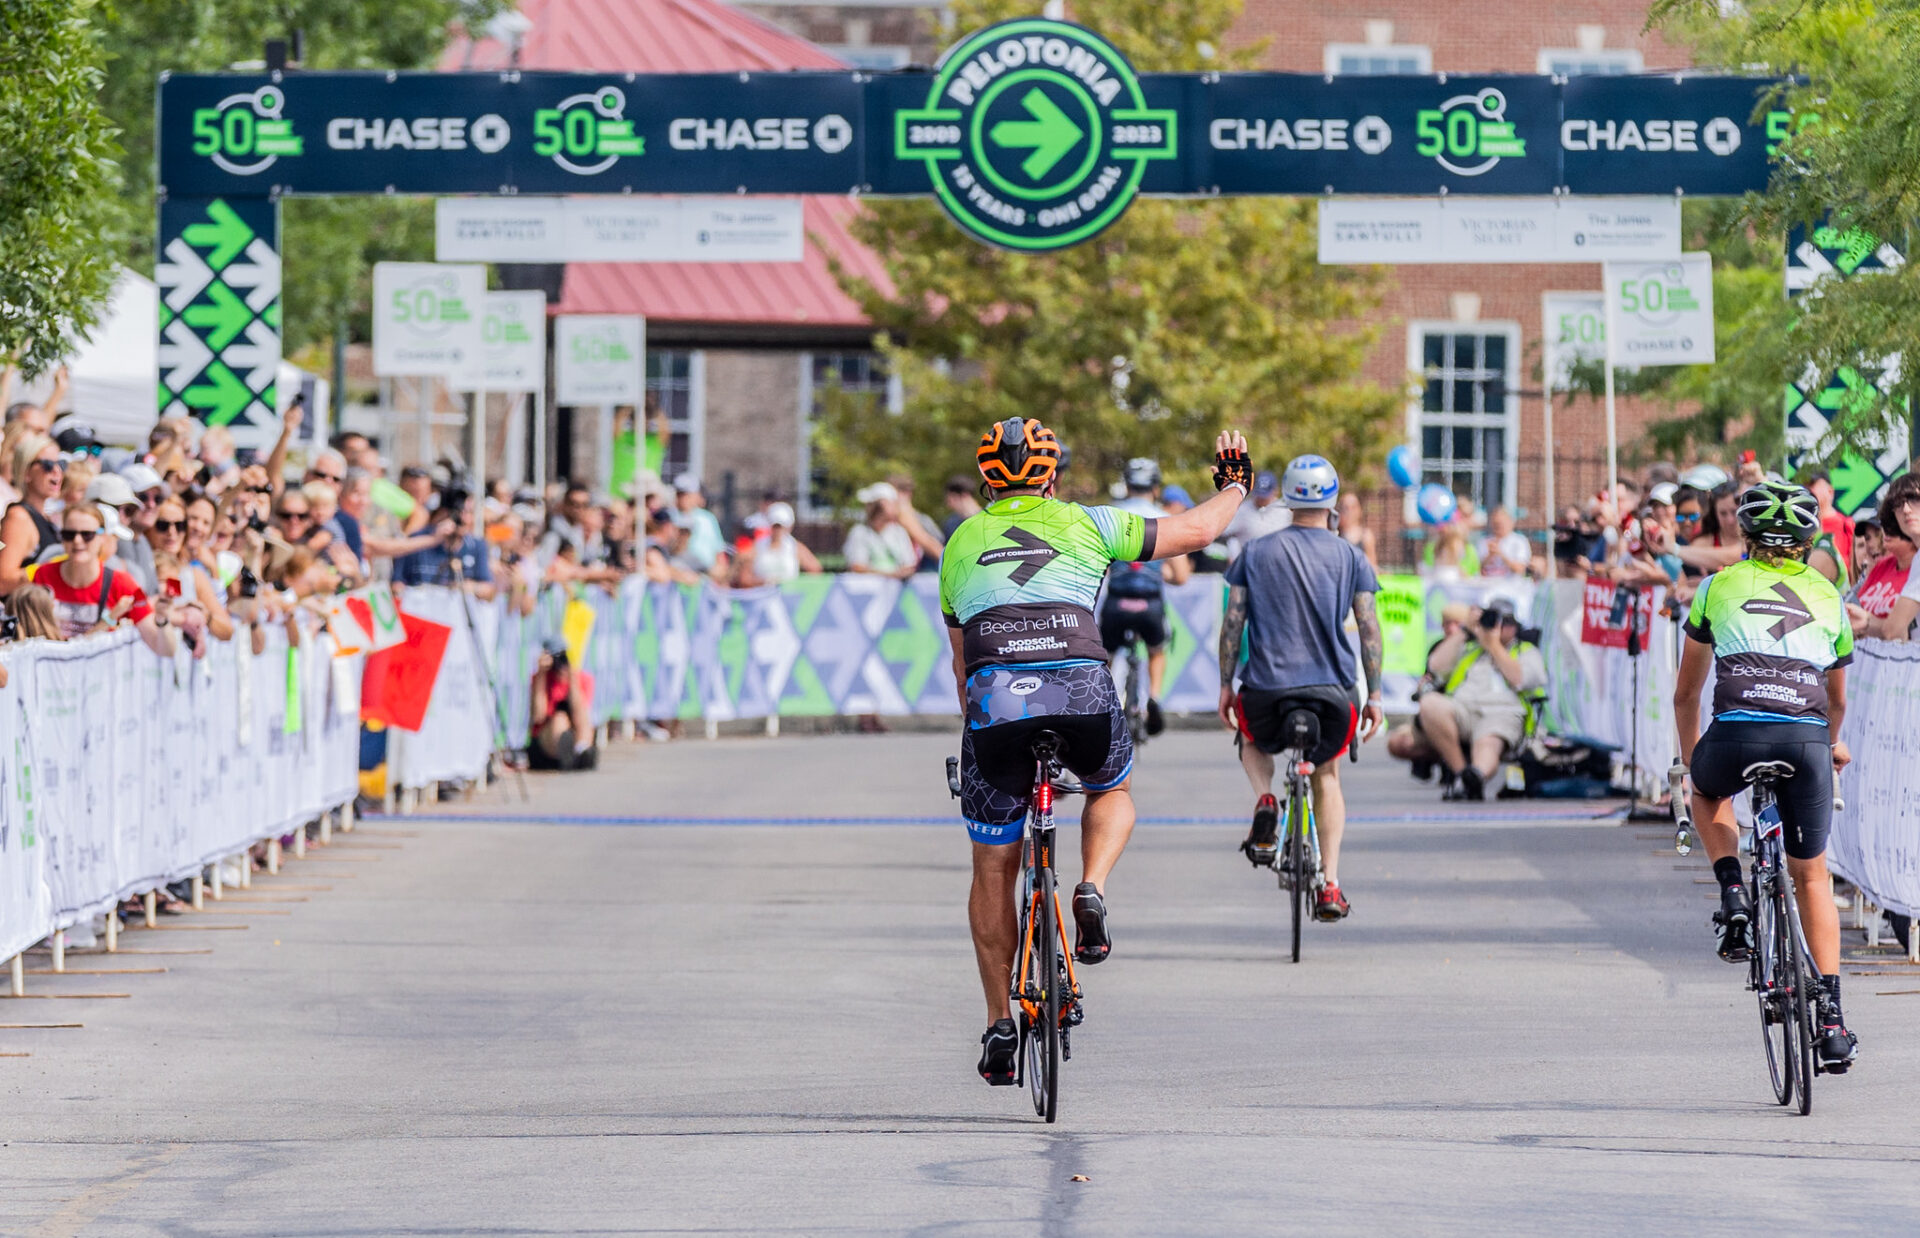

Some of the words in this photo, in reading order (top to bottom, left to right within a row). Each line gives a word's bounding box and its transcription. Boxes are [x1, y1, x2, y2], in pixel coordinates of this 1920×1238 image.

[947, 36, 1121, 106] PELOTONIA
[193, 108, 254, 156] 50
[327, 118, 467, 150] CHASE
[534, 108, 596, 156] 50
[669, 118, 809, 150] CHASE
[908, 125, 961, 144] 2009
[1112, 125, 1163, 144] 2023
[1209, 118, 1350, 150] CHASE
[1417, 109, 1478, 157] 50
[1561, 119, 1698, 152] CHASE
[967, 183, 1026, 226] YEARS
[1037, 201, 1081, 228] ONE
[1078, 166, 1122, 211] GOAL
[391, 289, 435, 322] 50
[1621, 280, 1663, 312] 50
[981, 551, 1006, 562] SIMPLY
[1006, 548, 1053, 557] COMMUNITY
[980, 614, 1079, 636] BeecherHill
[998, 642, 1068, 654] FOUNDATION
[1008, 636, 1055, 647] DODSON
[1731, 664, 1818, 686] BeecherHill
[1754, 683, 1797, 697] DODSON
[1743, 690, 1807, 706] FOUNDATION
